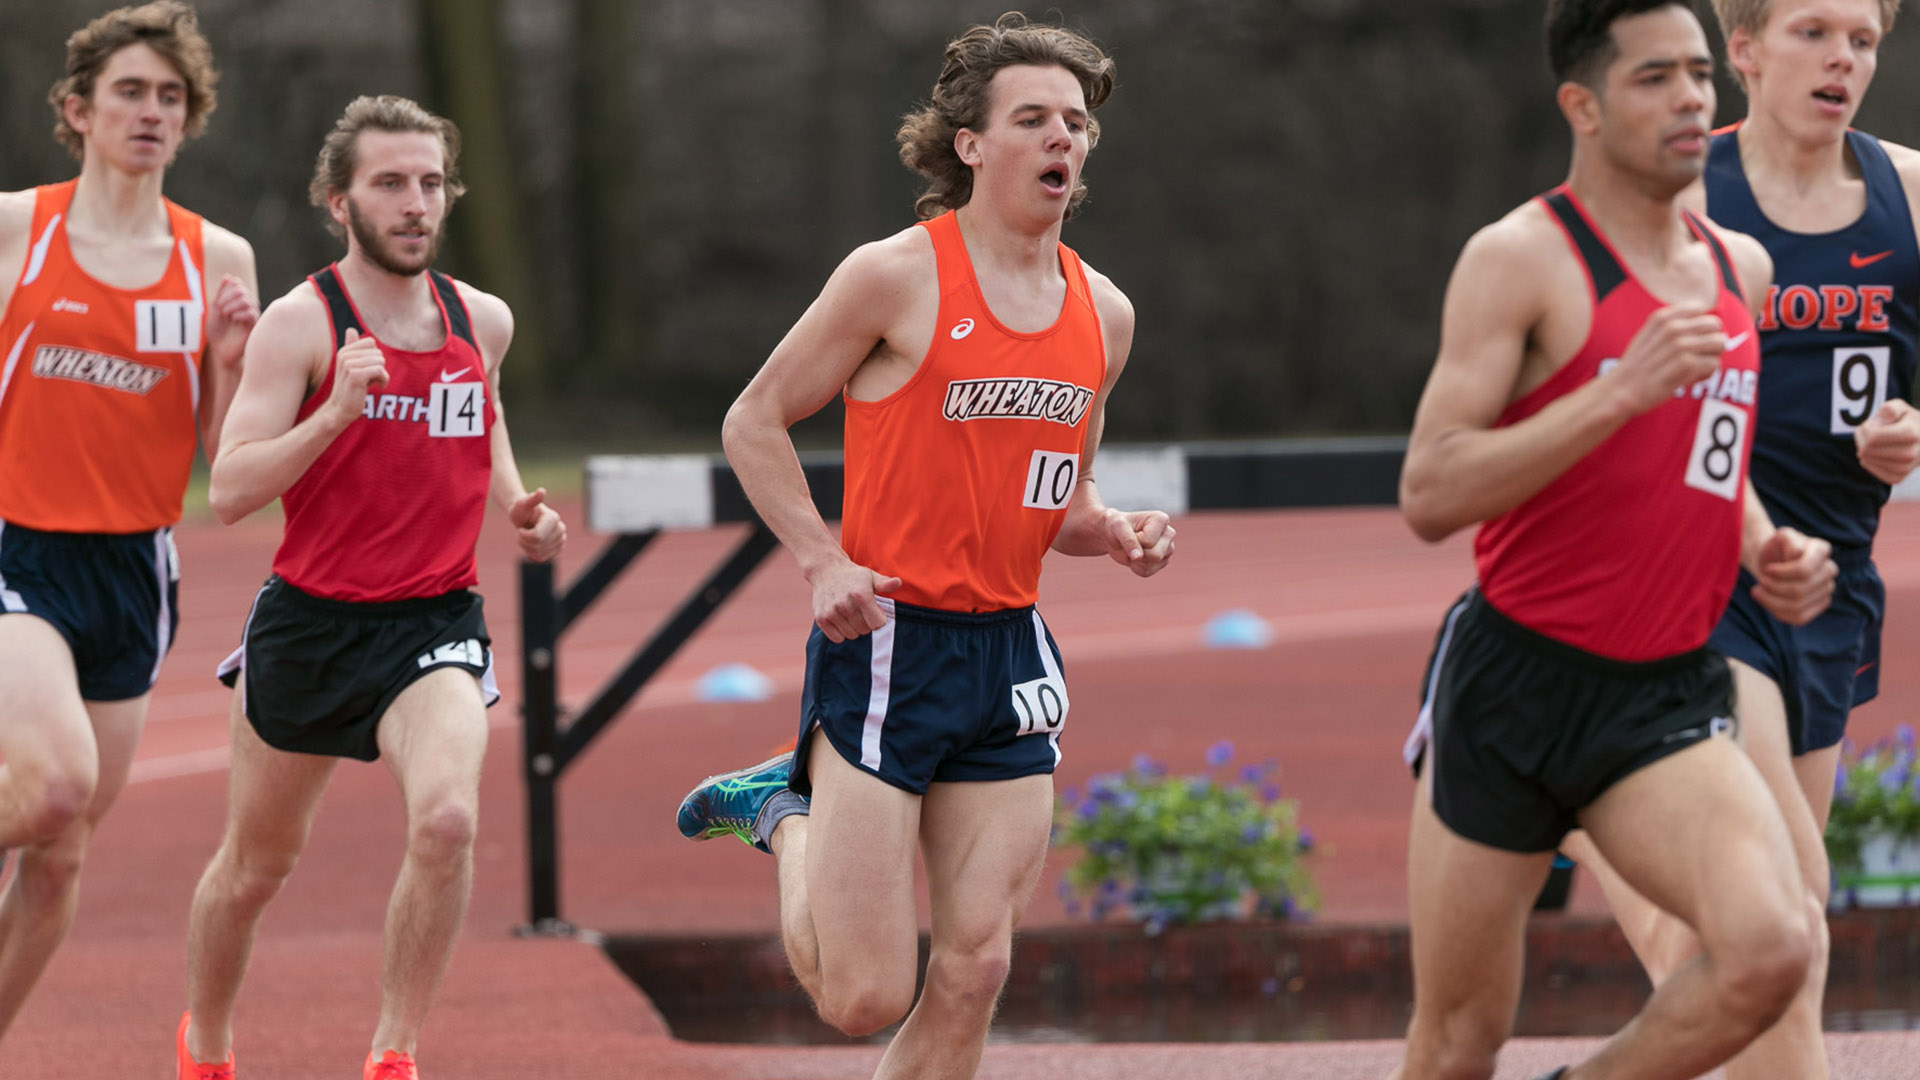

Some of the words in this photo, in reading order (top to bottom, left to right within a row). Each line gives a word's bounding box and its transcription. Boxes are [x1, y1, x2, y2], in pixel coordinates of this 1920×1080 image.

[151, 305, 186, 345] 11
[32, 344, 170, 395] WHEATON
[1839, 353, 1876, 426] 9
[440, 388, 476, 432] 14
[943, 378, 1095, 427] WHEATON
[1704, 414, 1737, 481] 8
[1032, 456, 1074, 505] 10
[1014, 683, 1063, 732] 10
